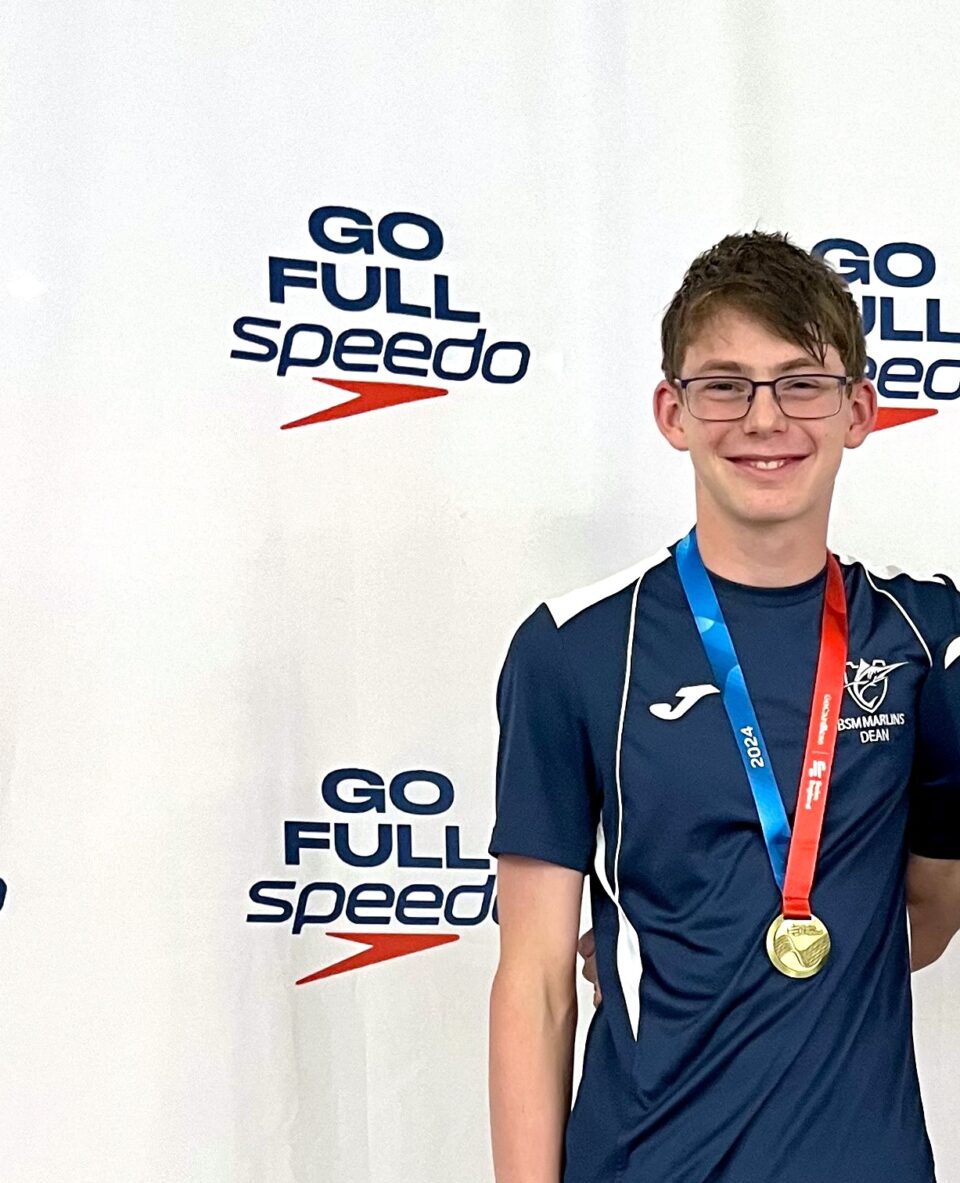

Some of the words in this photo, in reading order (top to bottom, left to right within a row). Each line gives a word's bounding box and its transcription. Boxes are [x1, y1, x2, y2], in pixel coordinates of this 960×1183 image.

[307, 205, 444, 262] GO
[811, 237, 936, 288] GO
[268, 255, 481, 324] FULL
[230, 316, 531, 385] speedo
[859, 729, 890, 744] DEAN
[862, 712, 906, 729] MARLINS
[739, 725, 765, 769] 2024
[321, 767, 455, 816] GO
[284, 820, 491, 870] FULL
[246, 874, 500, 935] speed
